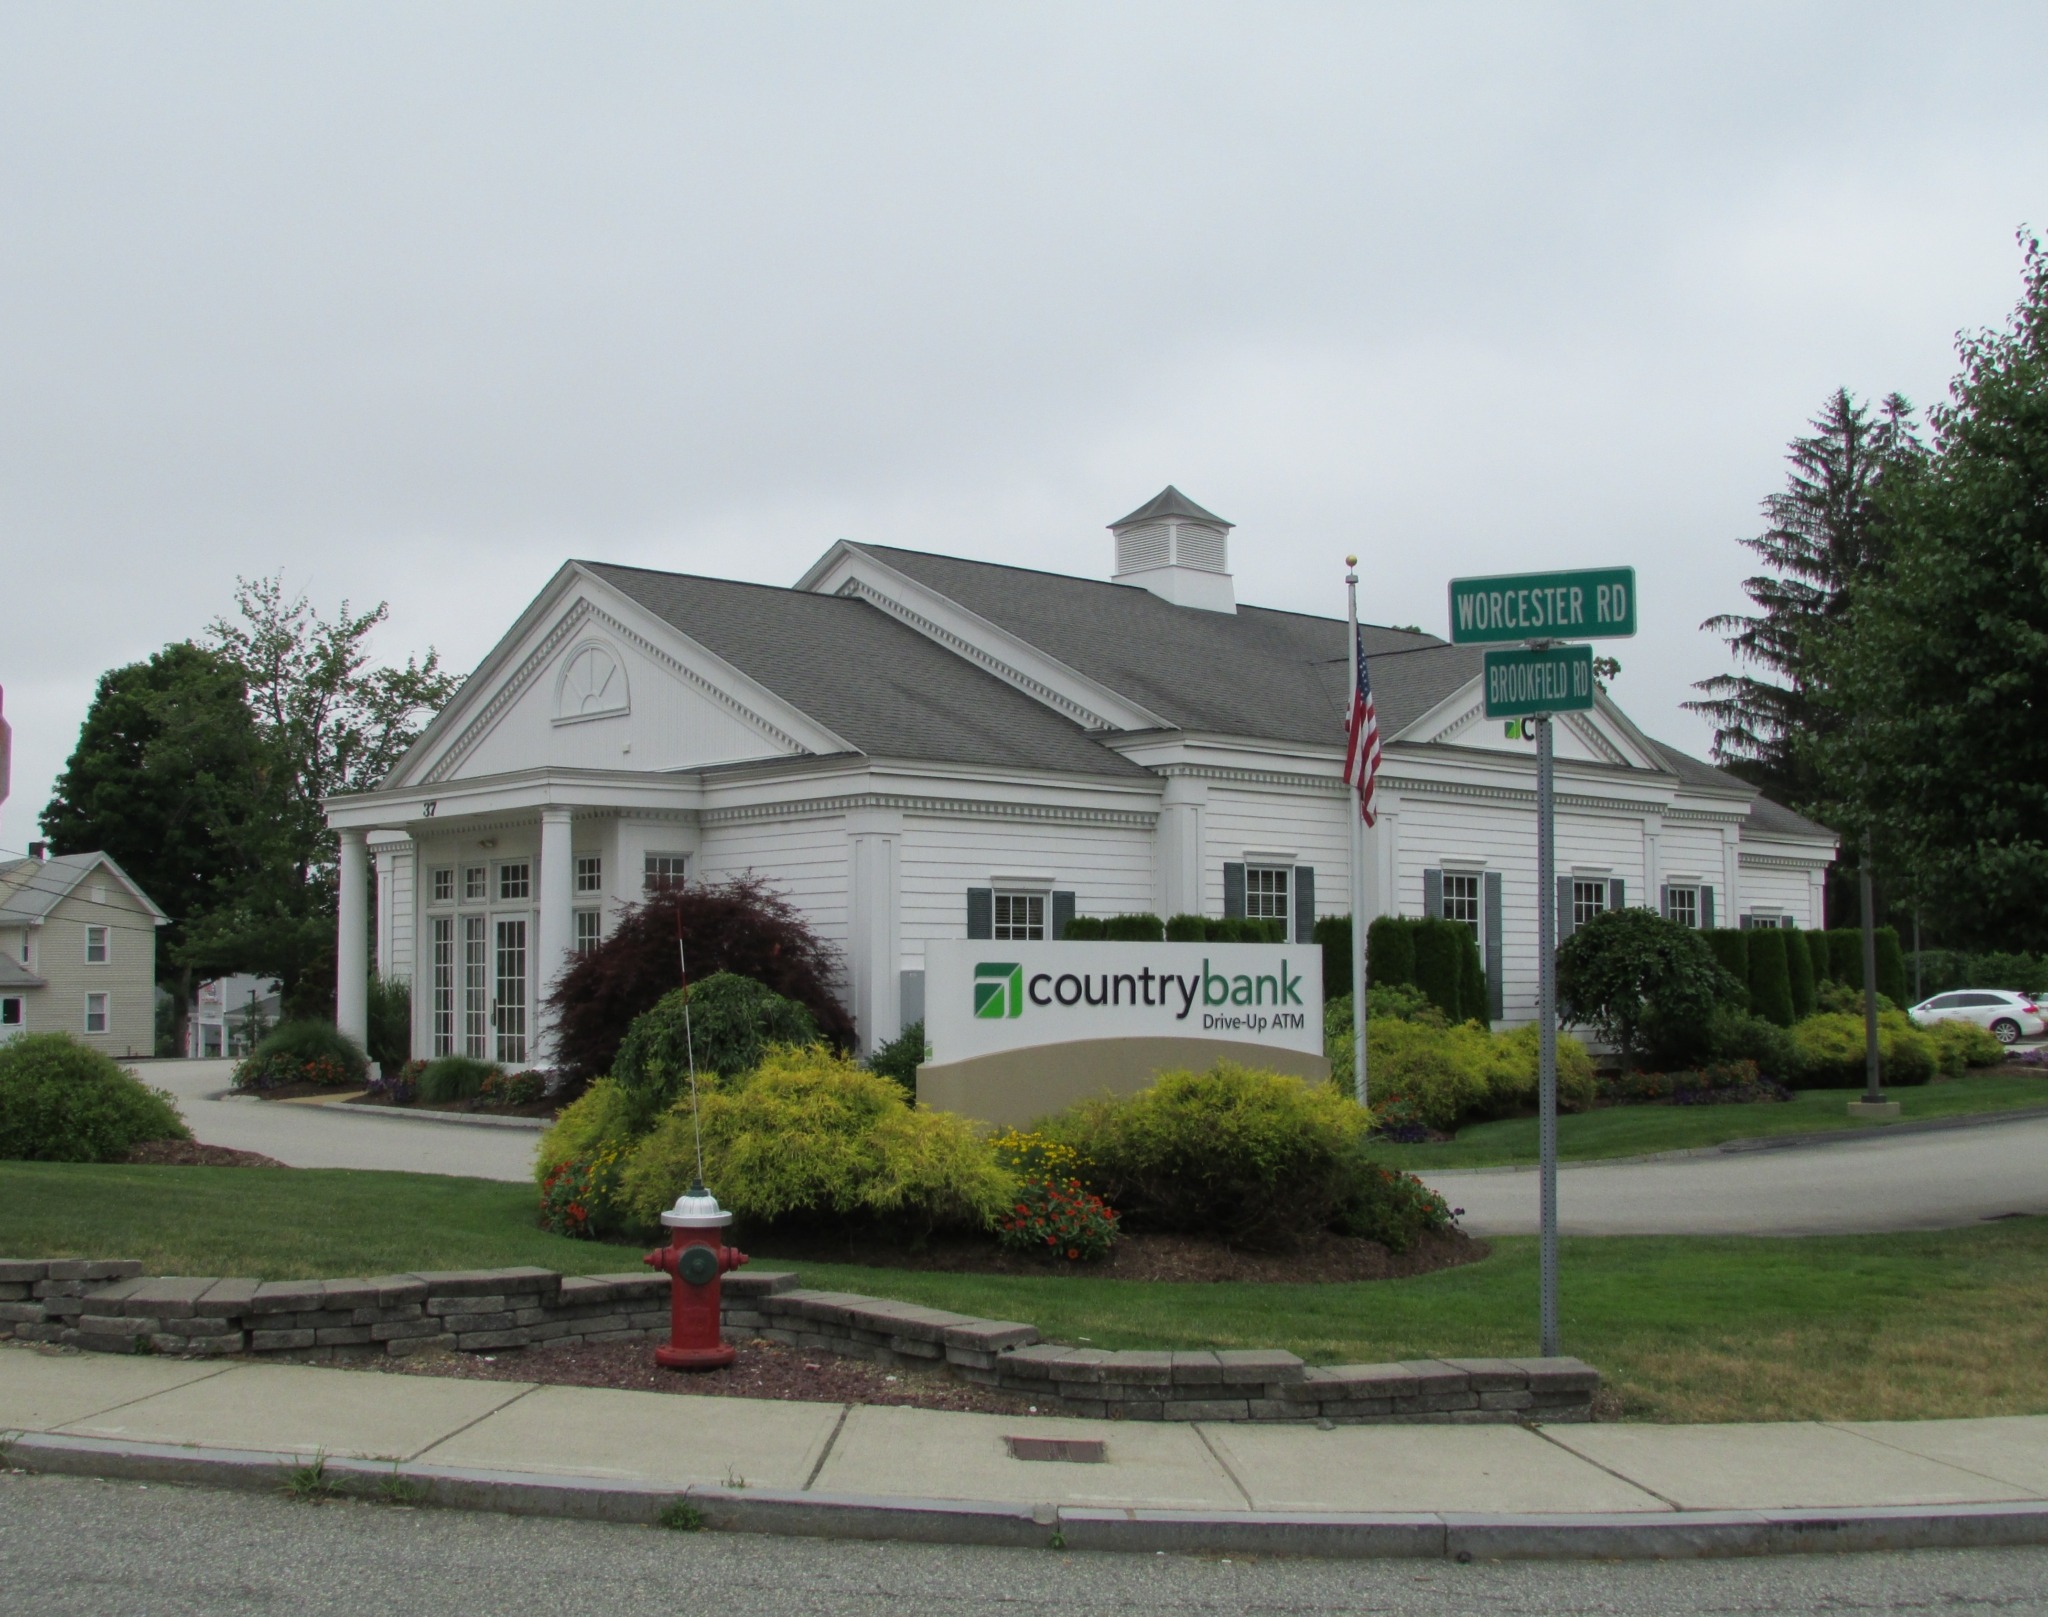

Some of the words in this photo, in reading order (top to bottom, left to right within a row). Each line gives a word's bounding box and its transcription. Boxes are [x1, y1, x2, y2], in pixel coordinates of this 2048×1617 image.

[1457, 586, 1584, 630] WORCESTER
[1596, 584, 1627, 624] RD
[1490, 661, 1568, 704] BROOKFIELD
[1573, 660, 1589, 697] RD
[422, 801, 438, 817] 37
[1028, 958, 1304, 1020] countrybank
[1203, 1013, 1268, 1034] Drive-Up
[1271, 1013, 1305, 1029] ATM
